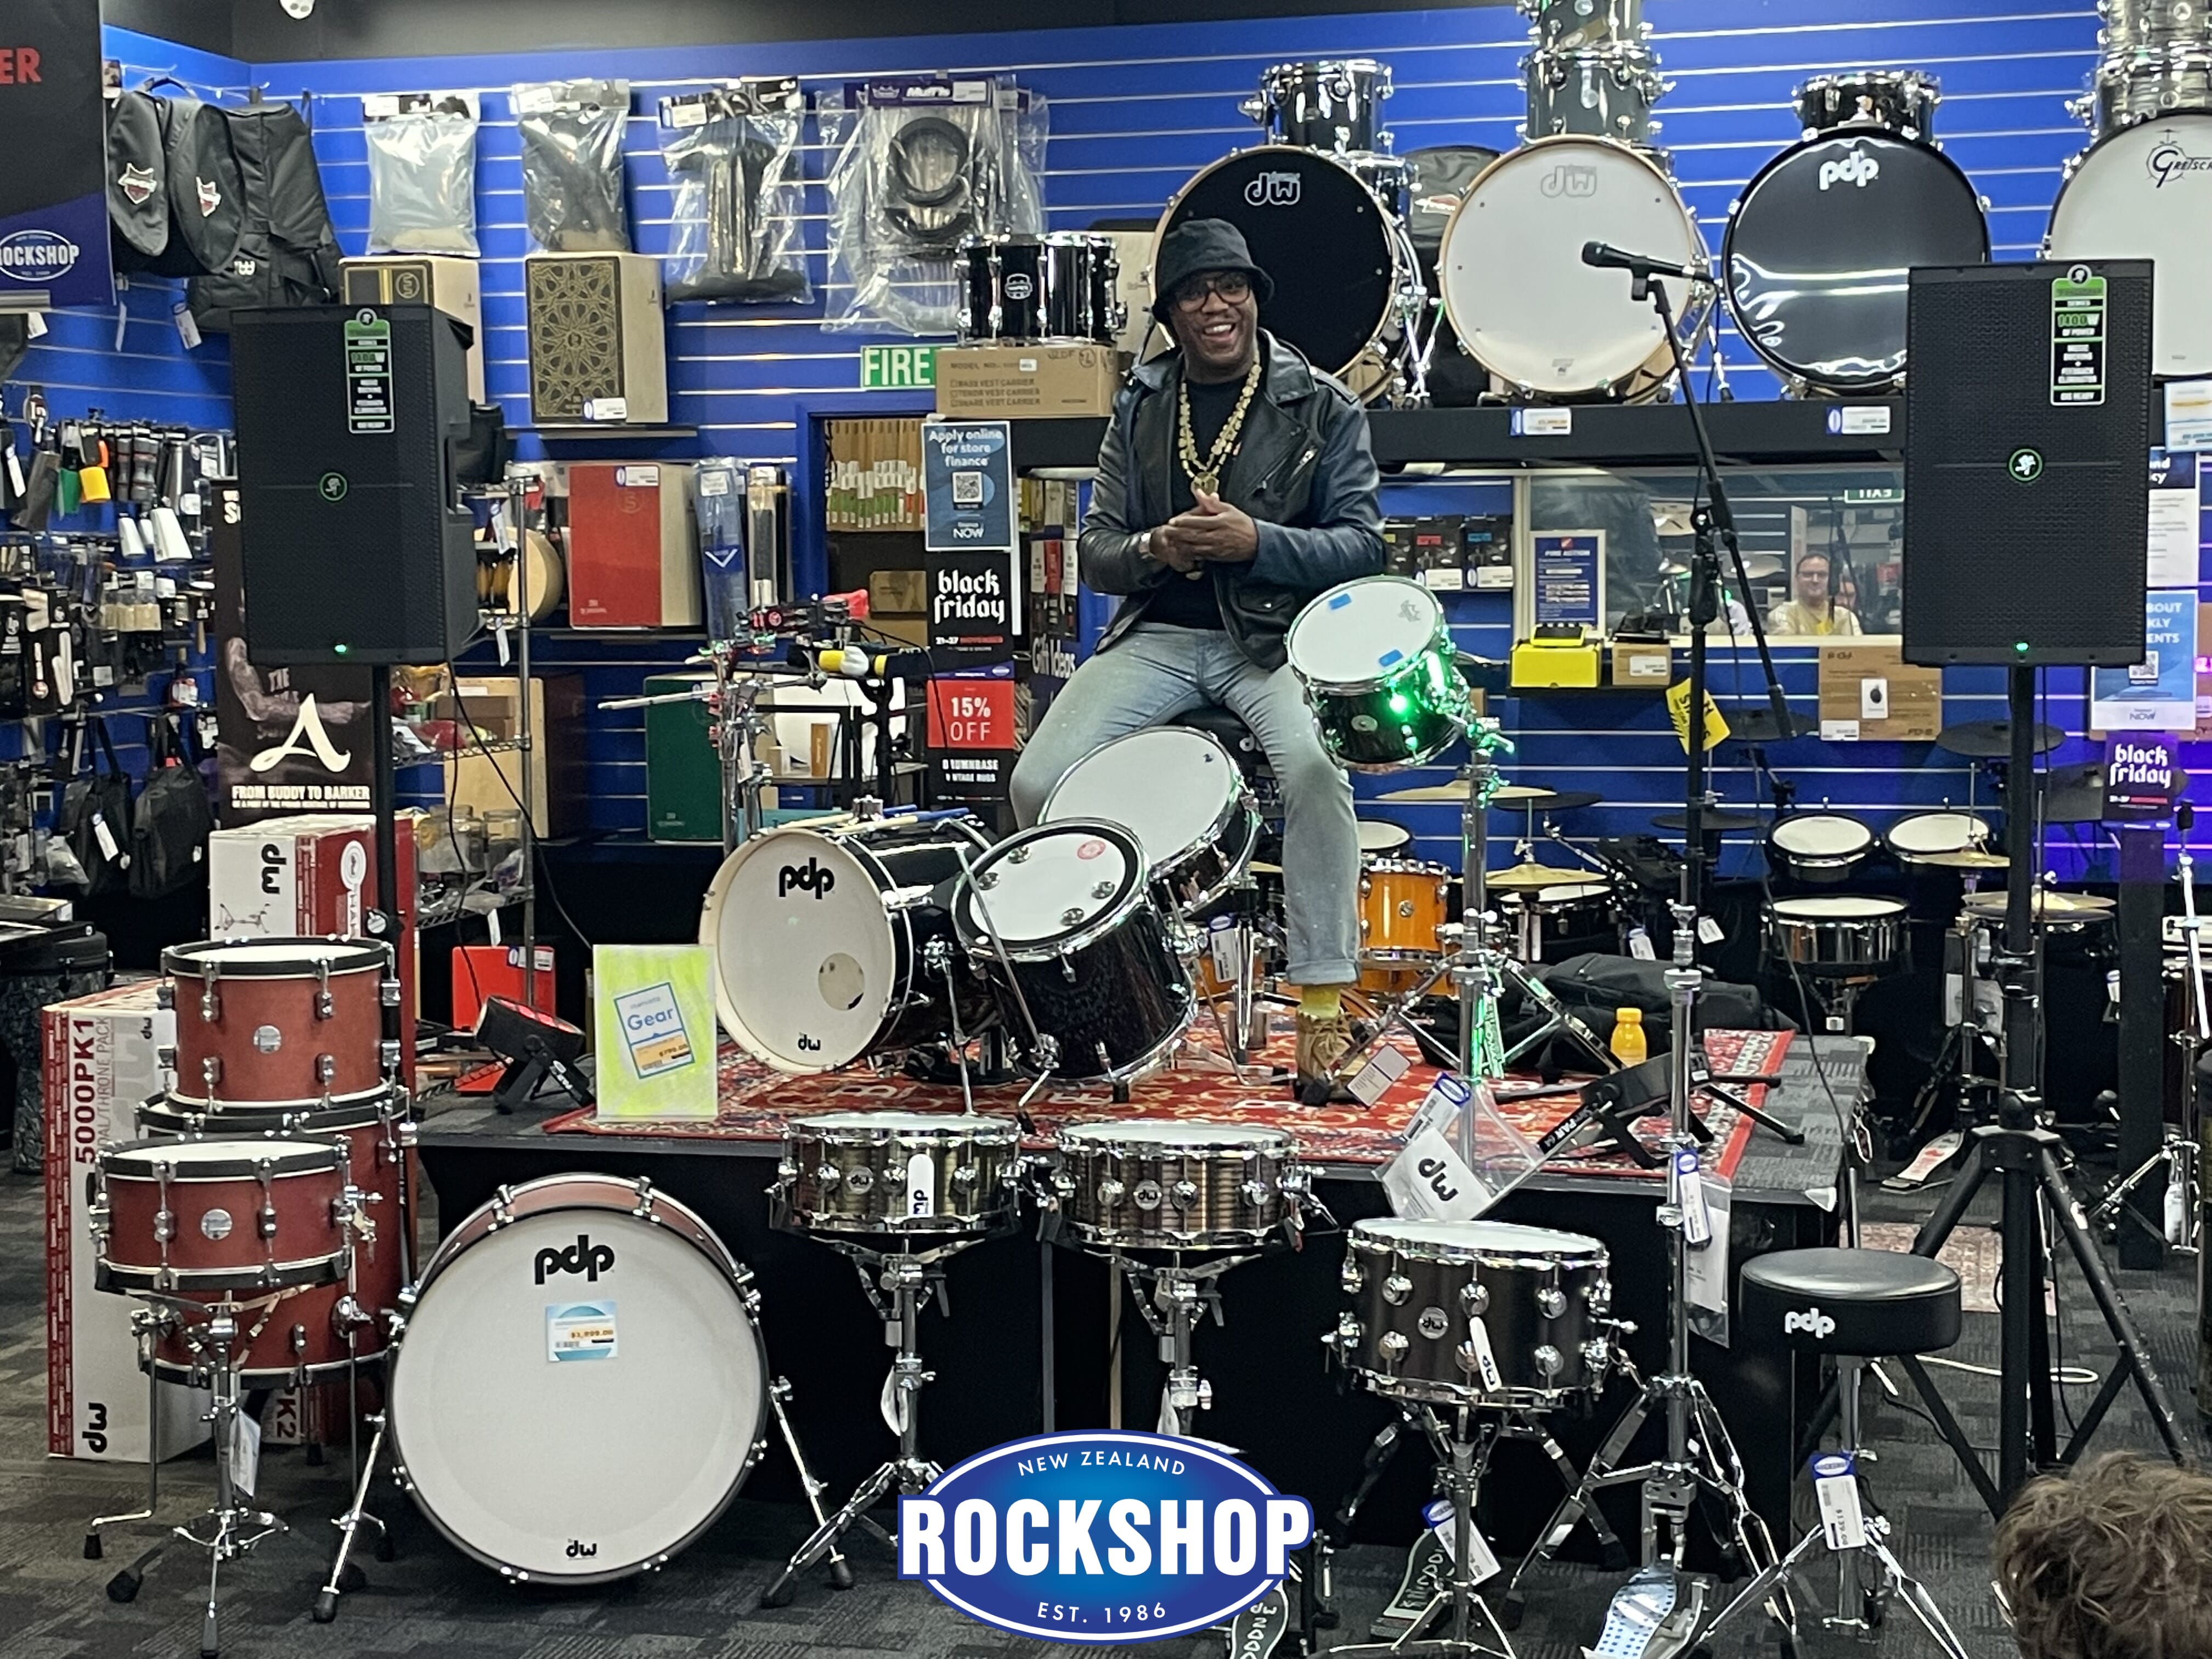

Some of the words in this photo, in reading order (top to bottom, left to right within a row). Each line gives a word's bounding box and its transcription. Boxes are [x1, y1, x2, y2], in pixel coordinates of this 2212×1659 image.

[1540, 166, 1598, 198] dw
[1819, 149, 1878, 190] pdp
[1244, 172, 1301, 206] dw
[0, 245, 80, 266] OCKSHOP
[864, 348, 931, 386] FIRE
[929, 428, 964, 444] Apply
[966, 428, 1002, 439] online
[941, 443, 958, 454] for
[960, 444, 991, 454] store
[952, 527, 984, 539] NOW
[938, 568, 1000, 595] black
[934, 594, 1006, 624] friday
[951, 696, 991, 718] 15%
[2129, 712, 2157, 721] NOW
[950, 721, 991, 741] OFF
[2114, 743, 2168, 767] black
[2109, 762, 2171, 789] friday
[232, 785, 266, 800] FROM
[267, 785, 306, 800] BUDDY
[307, 785, 323, 800] TO
[324, 785, 371, 800] BARKER
[261, 843, 287, 895] dw
[778, 856, 835, 900] pdp
[140, 1017, 153, 1040] dw
[627, 1008, 674, 1030] Gear
[95, 1016, 110, 1053] PACK
[798, 1034, 821, 1051] dw
[72, 1019, 96, 1164] 5000PK1
[1418, 1158, 1459, 1202] dw
[534, 1234, 615, 1285] pdp
[1784, 1307, 1836, 1339] pdp
[81, 1402, 108, 1454] dw
[566, 1539, 597, 1557] dw
